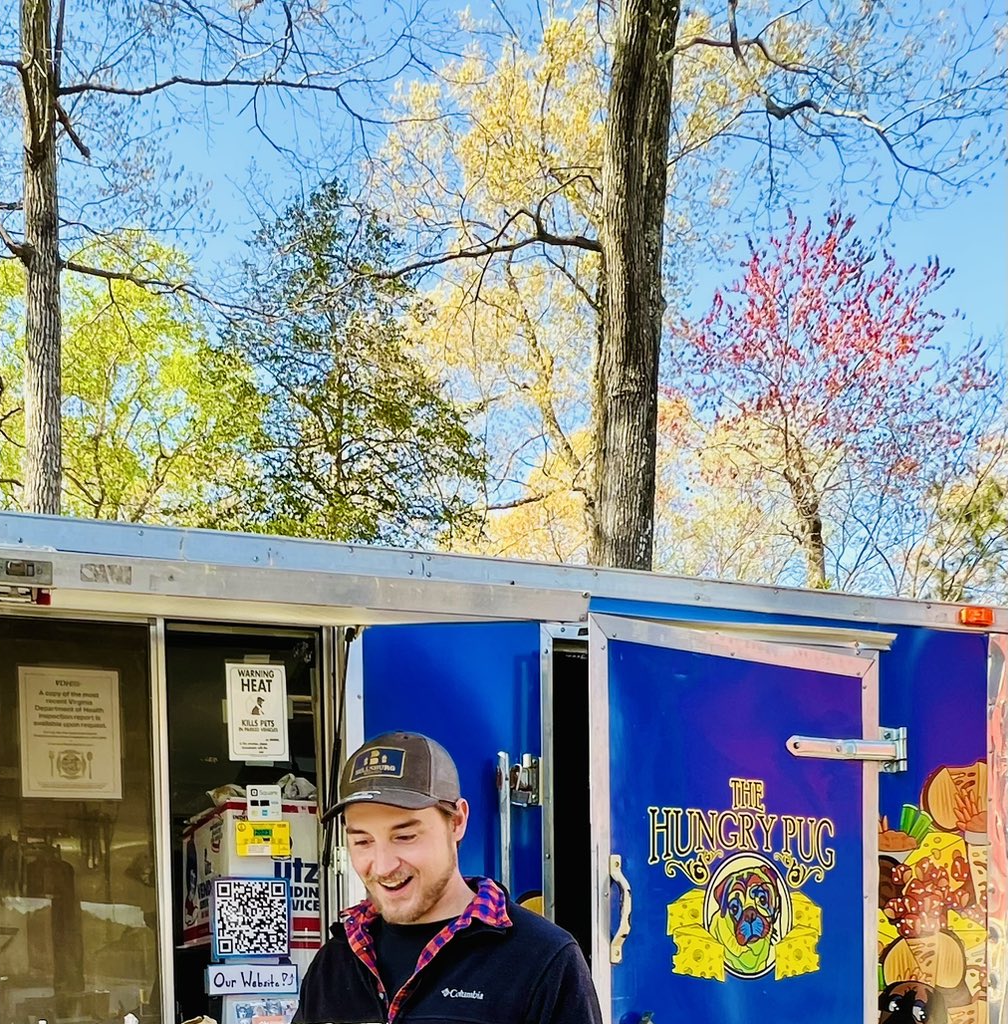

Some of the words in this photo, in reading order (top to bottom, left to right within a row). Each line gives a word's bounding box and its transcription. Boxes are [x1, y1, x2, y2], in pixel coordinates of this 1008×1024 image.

[237, 669, 275, 678] WARNING
[241, 678, 272, 692] HEAT
[729, 778, 765, 812] THE
[647, 806, 777, 864] HUNGRY
[781, 816, 835, 870] PUG
[274, 857, 319, 883] utz
[291, 899, 320, 911] VICE
[213, 972, 236, 988] Our
[450, 988, 484, 1000] Columbia
